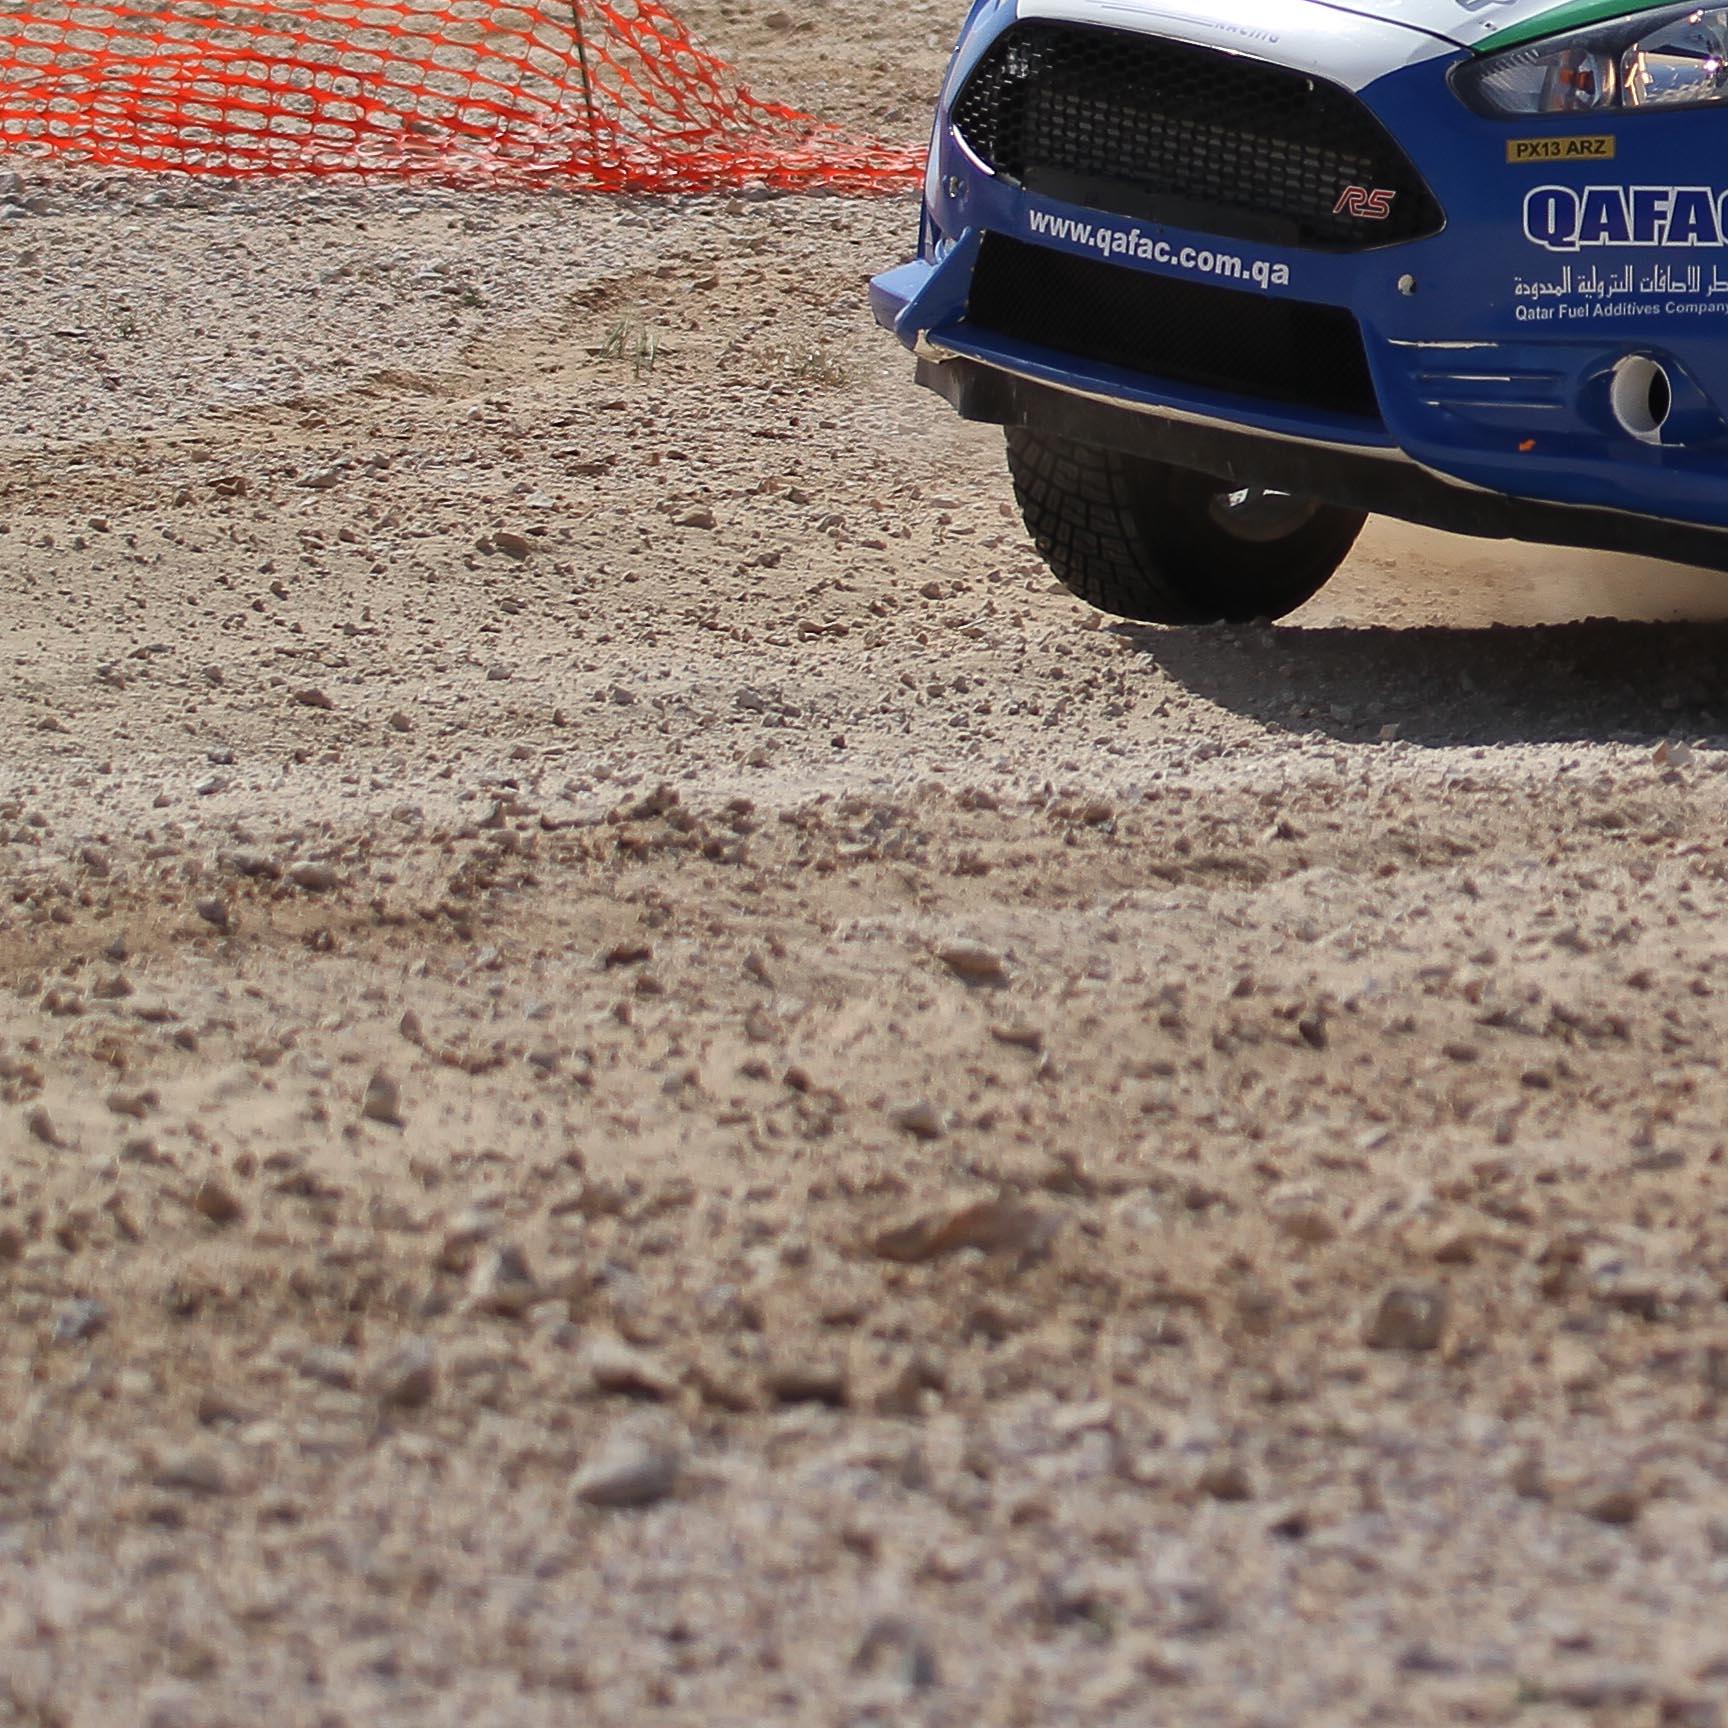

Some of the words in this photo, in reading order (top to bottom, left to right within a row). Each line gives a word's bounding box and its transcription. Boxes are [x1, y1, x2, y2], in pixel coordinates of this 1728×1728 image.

[1516, 141, 1561, 158] PX13
[1566, 139, 1607, 155] ARZ
[1028, 208, 1290, 290] www.qafac.com.qa
[1514, 303, 1555, 322] Qatar
[1558, 302, 1590, 319] Fuel
[1592, 301, 1661, 318] Additives
